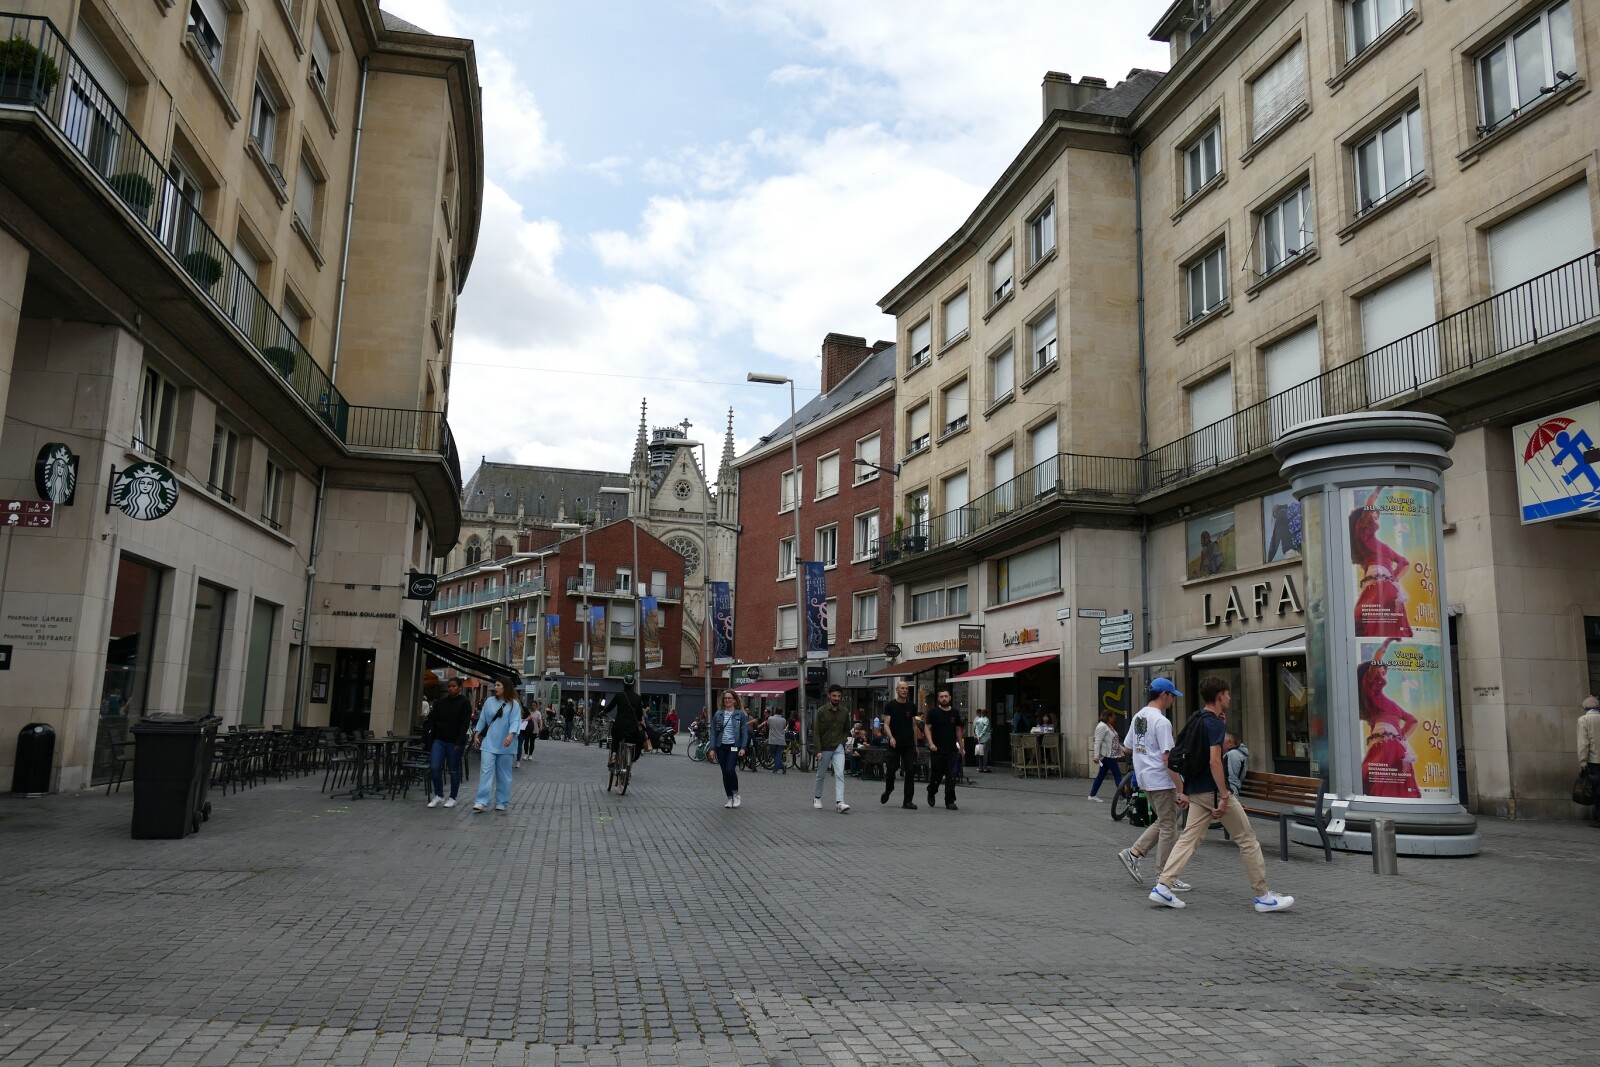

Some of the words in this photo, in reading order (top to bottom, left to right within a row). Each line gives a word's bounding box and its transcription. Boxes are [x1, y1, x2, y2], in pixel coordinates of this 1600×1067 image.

[1386, 496, 1414, 504] Voyage
[1394, 651, 1424, 660] Voyage
[846, 669, 866, 677] MATY
[1428, 736, 1442, 756] 29
